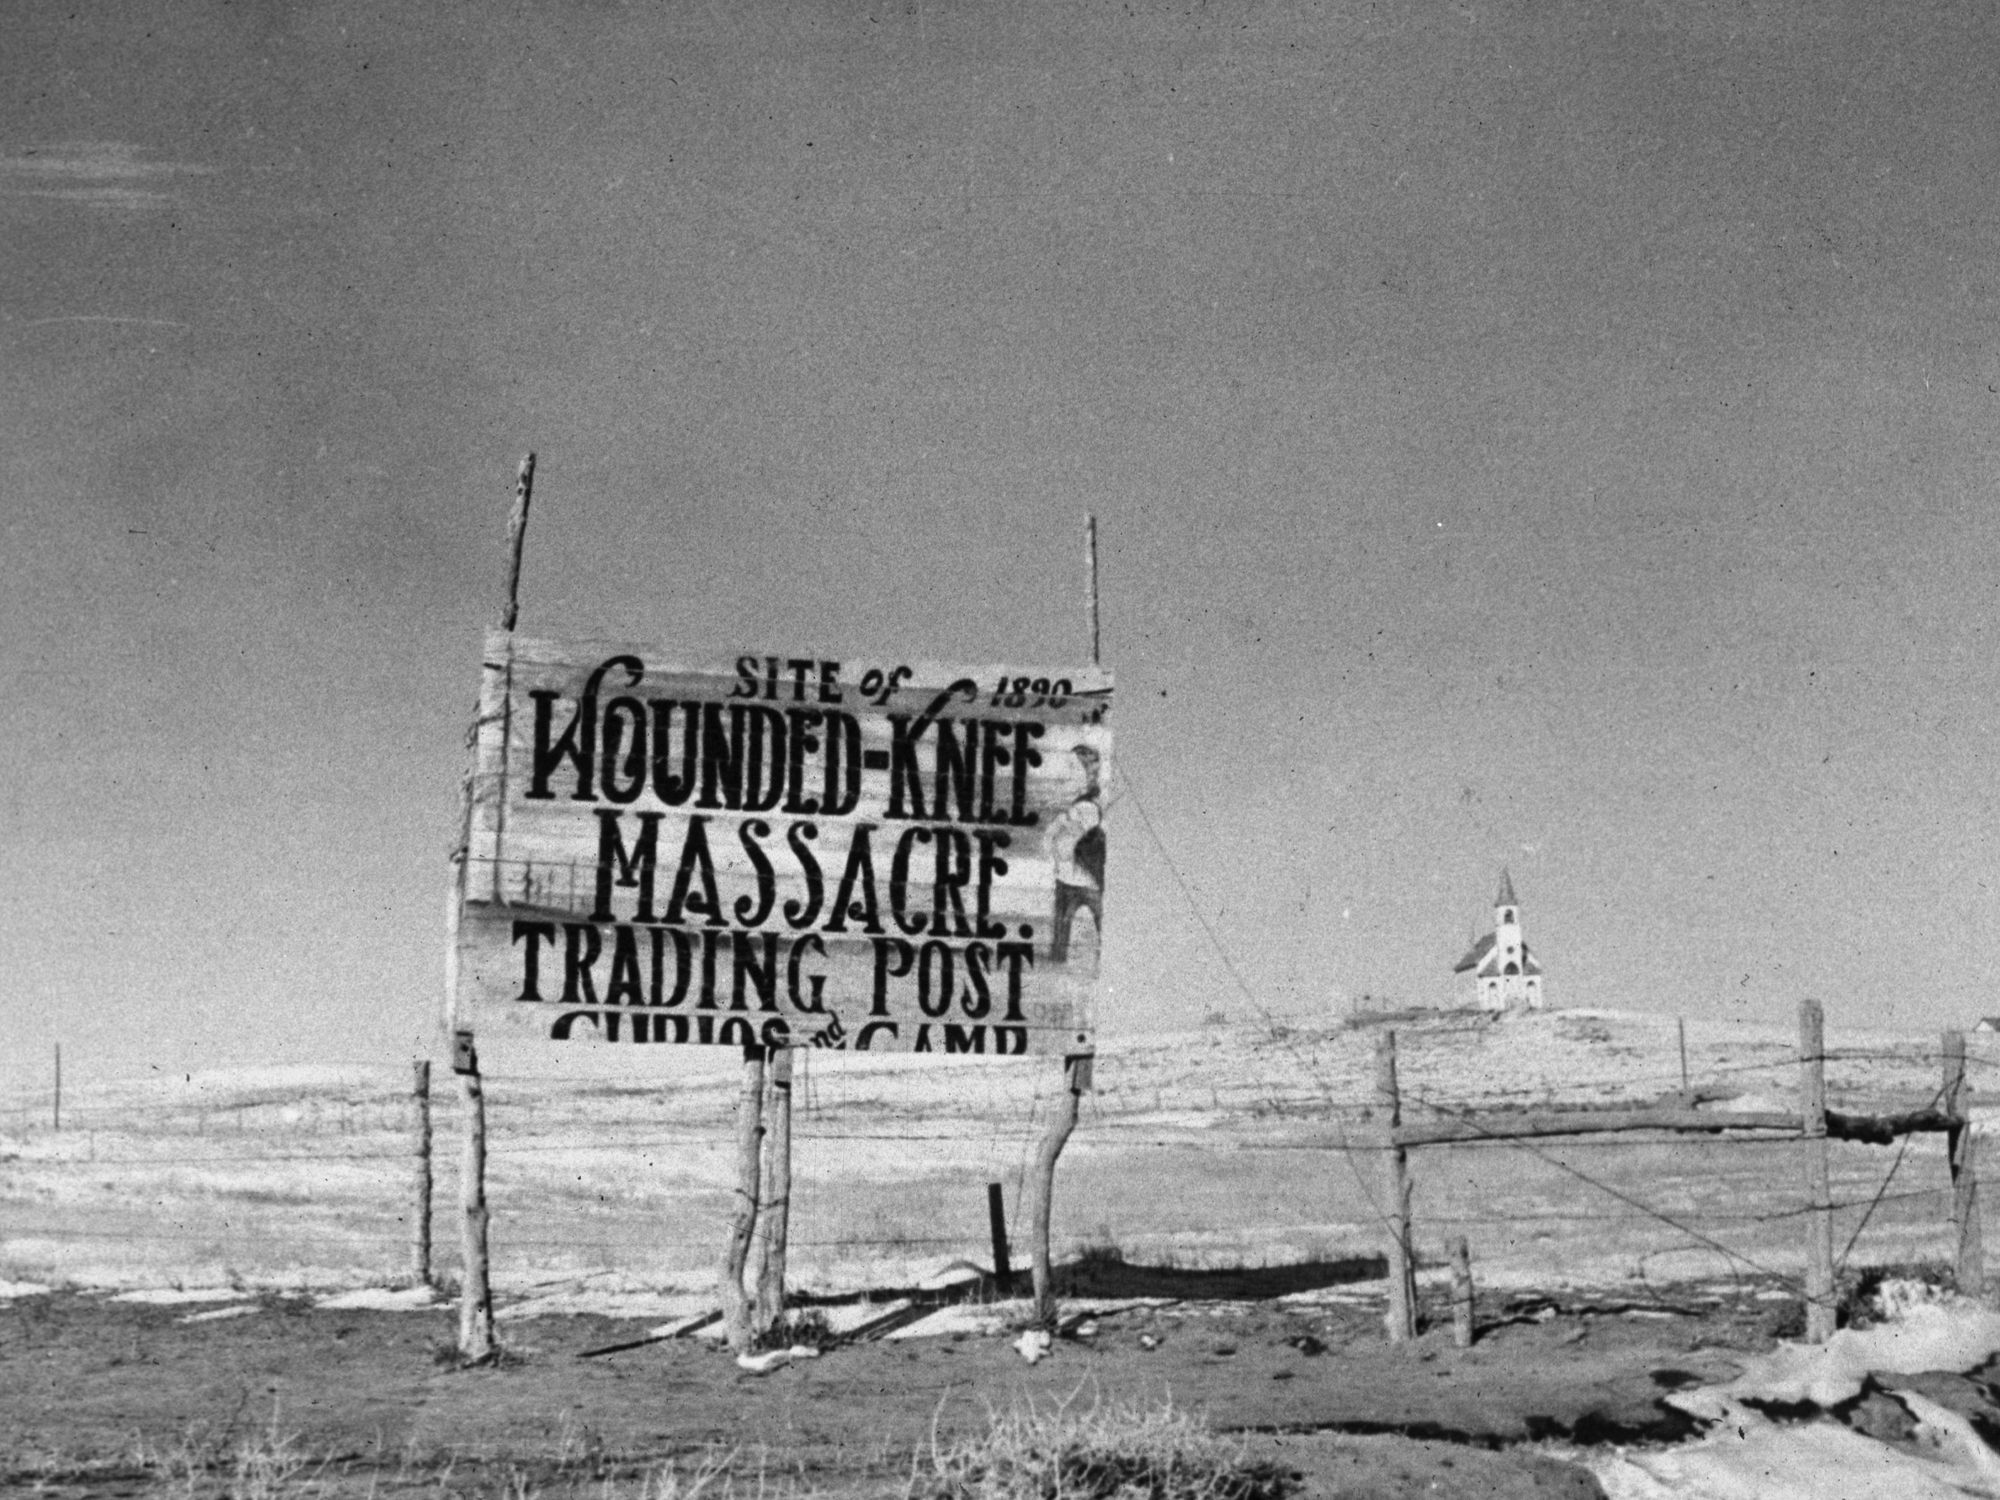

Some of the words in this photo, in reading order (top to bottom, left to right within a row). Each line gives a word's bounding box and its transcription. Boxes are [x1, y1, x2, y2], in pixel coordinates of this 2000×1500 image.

[728, 655, 843, 701] SITE
[859, 665, 914, 706] of
[990, 676, 1074, 710] 1890
[526, 655, 1045, 826] WOUNDED-KNEE
[512, 920, 830, 1015] TRADING
[869, 937, 1035, 1022] POST
